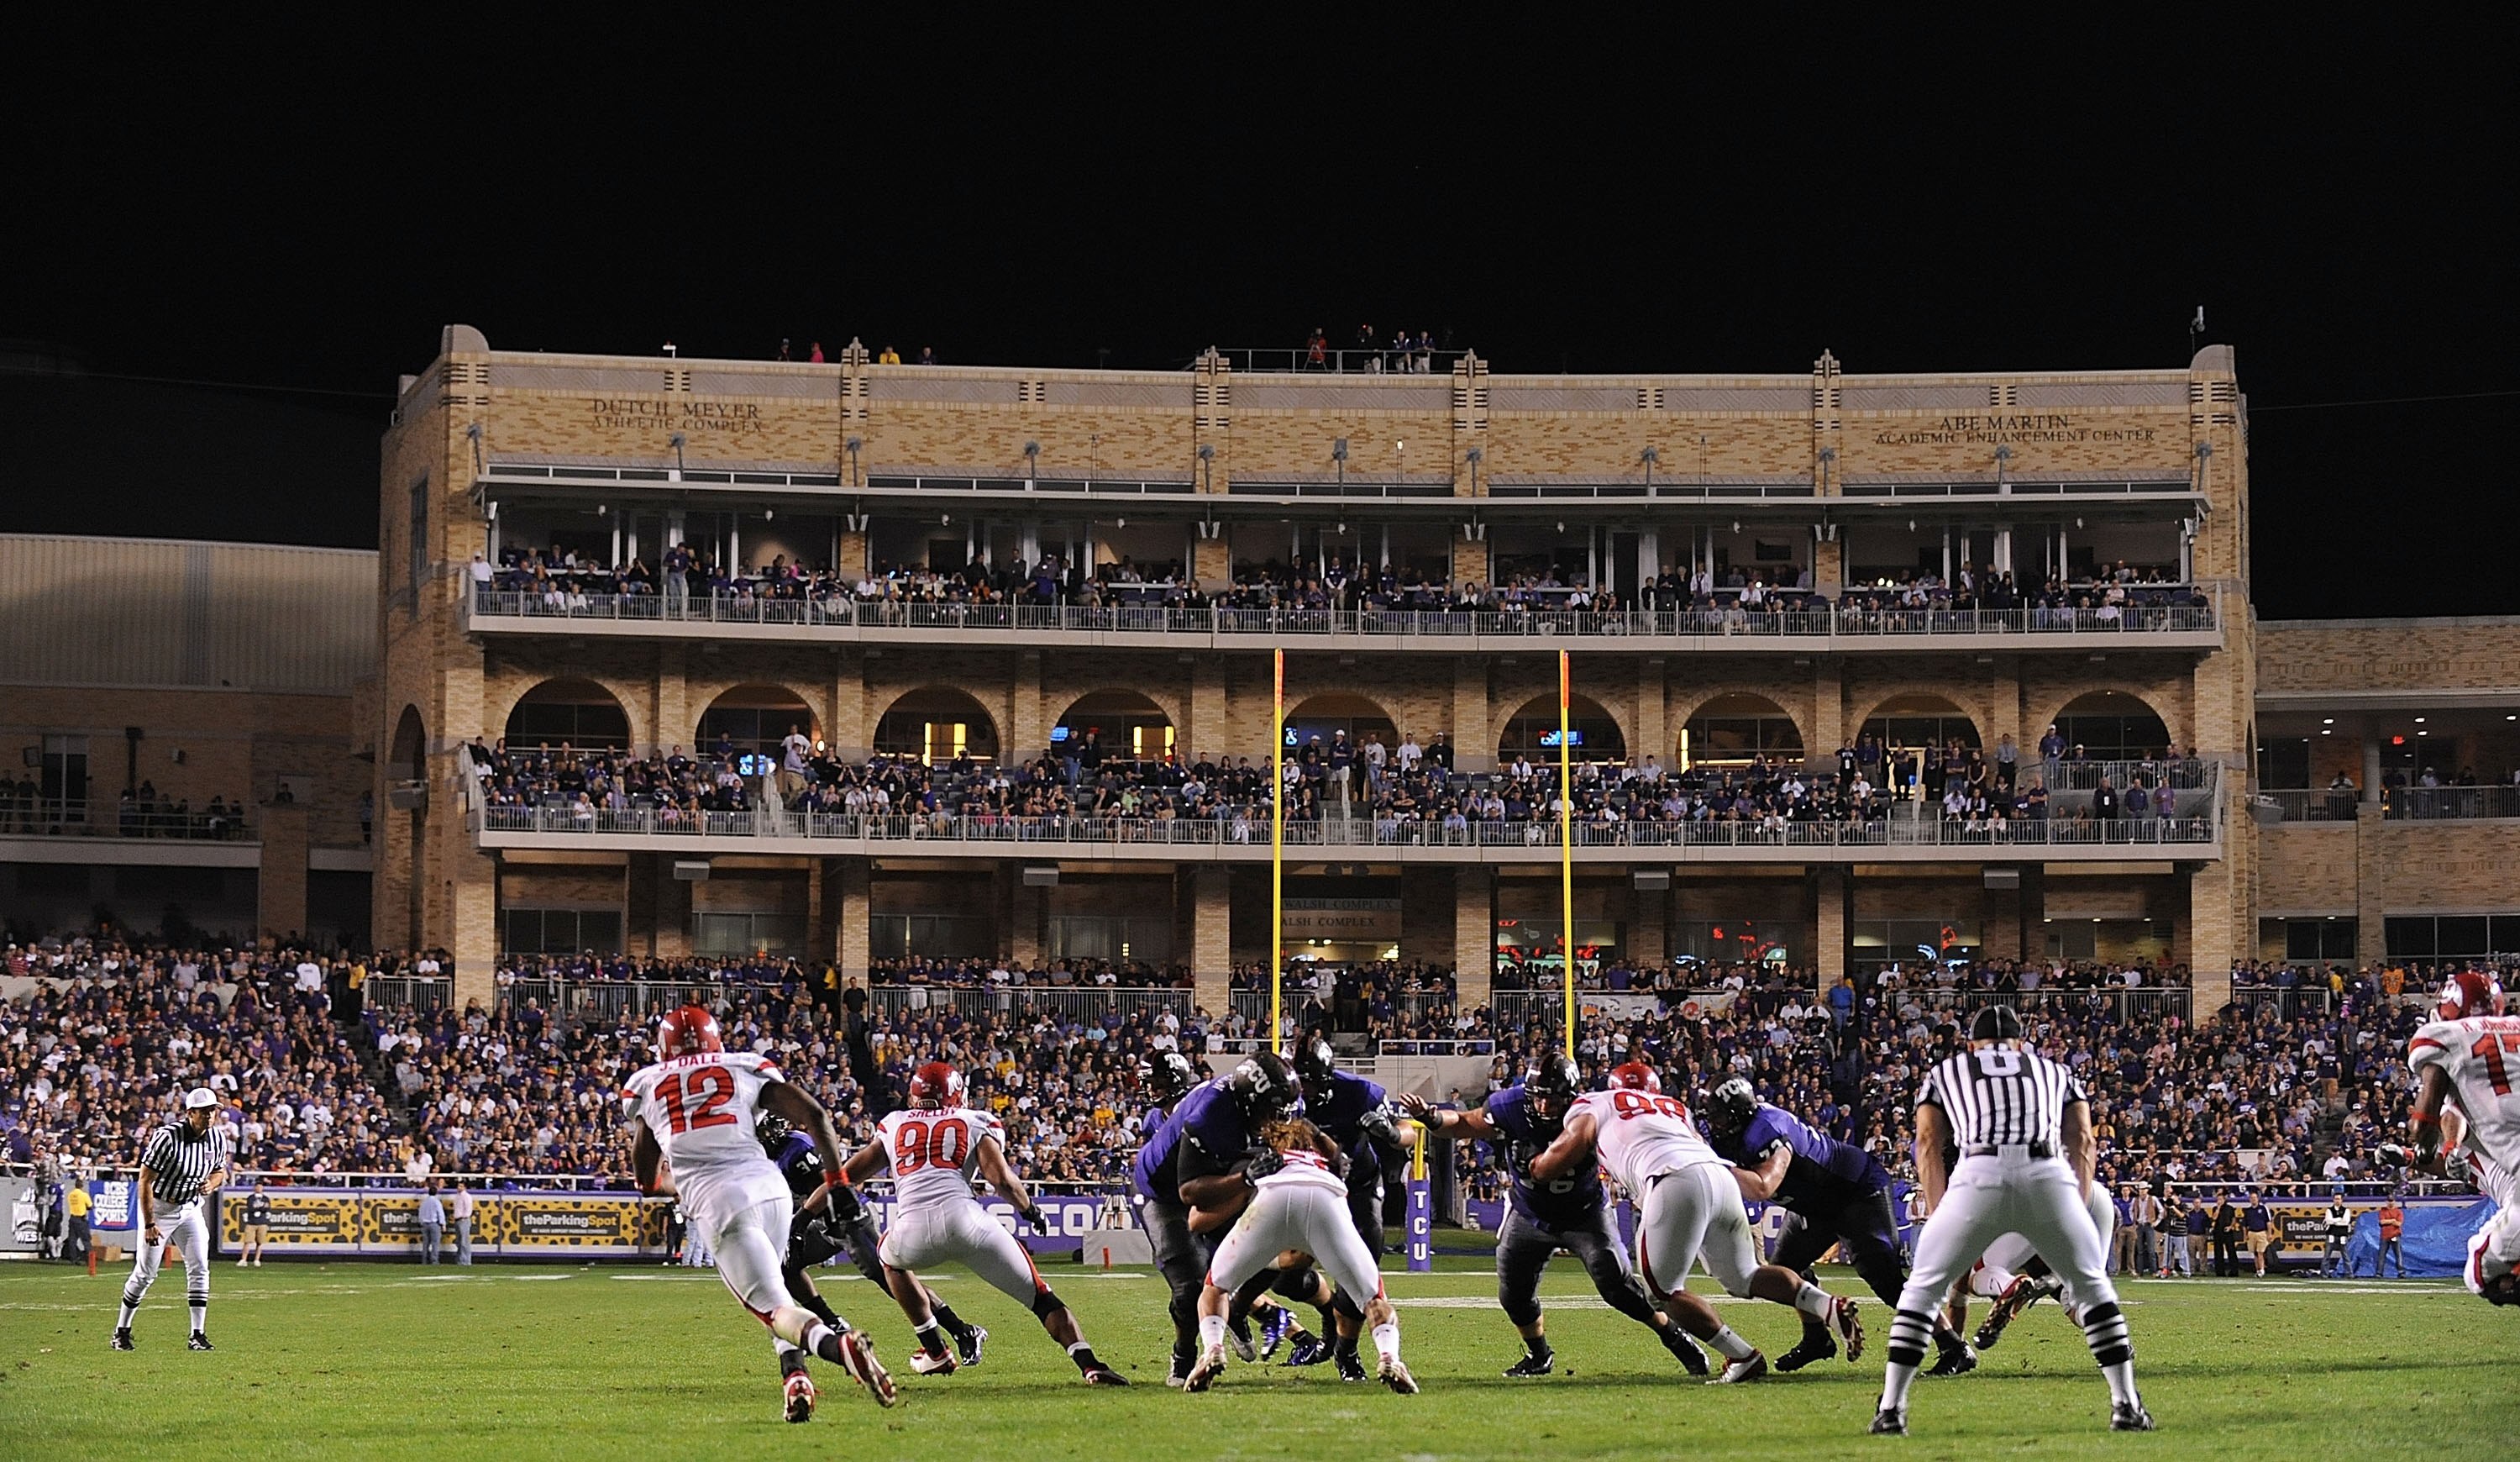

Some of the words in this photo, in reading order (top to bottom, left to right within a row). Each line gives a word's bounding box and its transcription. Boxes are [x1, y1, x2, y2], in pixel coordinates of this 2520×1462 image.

[593, 399, 669, 416] DUTCH
[682, 402, 759, 418] MEYER
[592, 415, 672, 429] ATHLETIC
[682, 419, 762, 433] COMPLEX
[1940, 417, 1981, 431] ABE
[1987, 415, 2069, 430] MARTIN
[1875, 433, 1960, 444] ACADEMIC
[1966, 431, 2087, 444] ENHANCEMENT
[2092, 429, 2155, 442] CENTER
[1284, 899, 1326, 909] WALSH
[1333, 899, 1393, 909] COMPLEX
[1282, 917, 1311, 927] ALSH
[1318, 917, 1375, 927] COMPLEX
[678, 1054, 722, 1067] DALE
[1714, 1078, 1753, 1103] TCU
[654, 1065, 738, 1134] 12
[895, 1118, 969, 1176] 90
[795, 1150, 821, 1175] 34
[94, 1194, 129, 1208] COLLEGE
[94, 1207, 129, 1226] SPORTS
[522, 1214, 617, 1228] theParkingSpot
